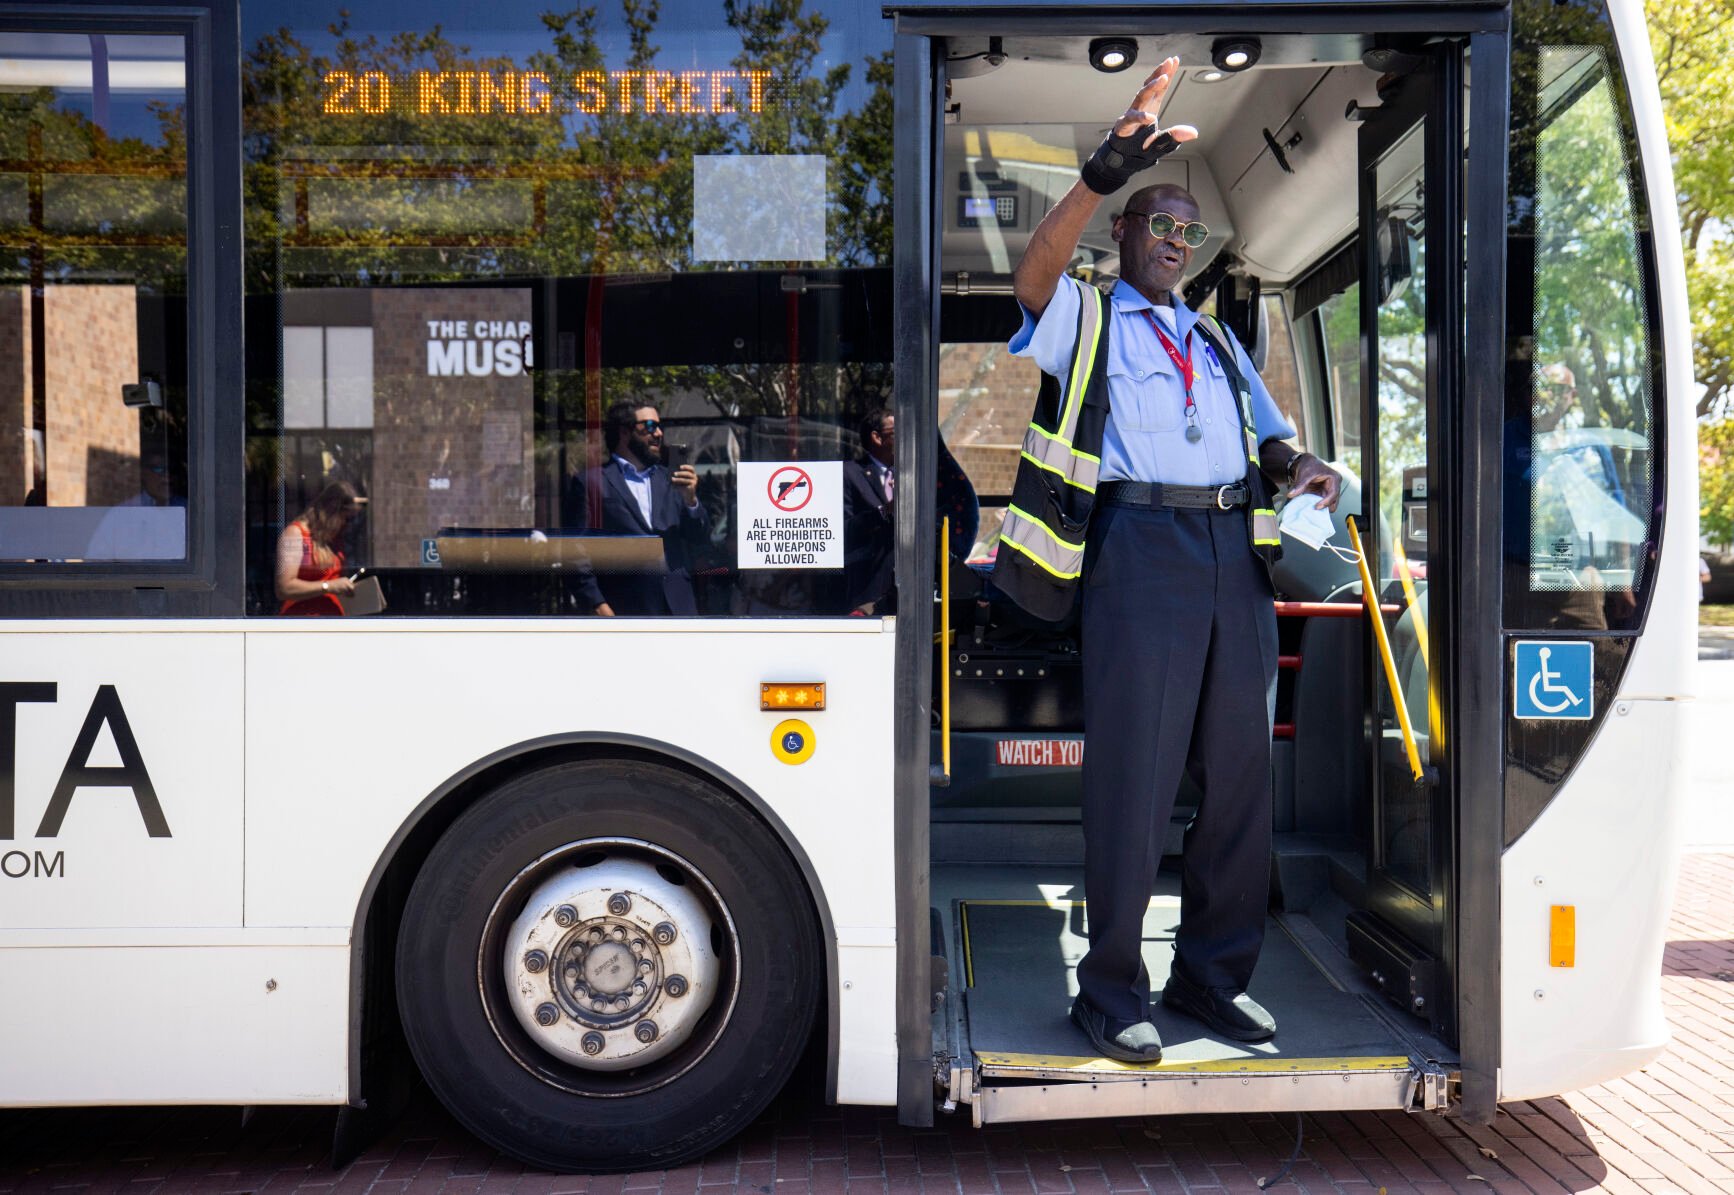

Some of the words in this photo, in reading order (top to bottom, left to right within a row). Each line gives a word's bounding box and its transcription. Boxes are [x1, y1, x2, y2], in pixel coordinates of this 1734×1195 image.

[323, 70, 391, 114] 20
[419, 70, 551, 114] KING
[576, 70, 772, 114] STREET
[427, 320, 469, 339] THE
[752, 518, 772, 529] ALL
[775, 517, 829, 529] FIREARMS
[746, 530, 767, 541] ARE
[770, 529, 835, 541] PROHIBITED.
[756, 542, 771, 553] NO
[774, 541, 826, 553] WEAPONS
[764, 553, 818, 565] ALLOWED.
[999, 740, 1053, 765] WATCH
